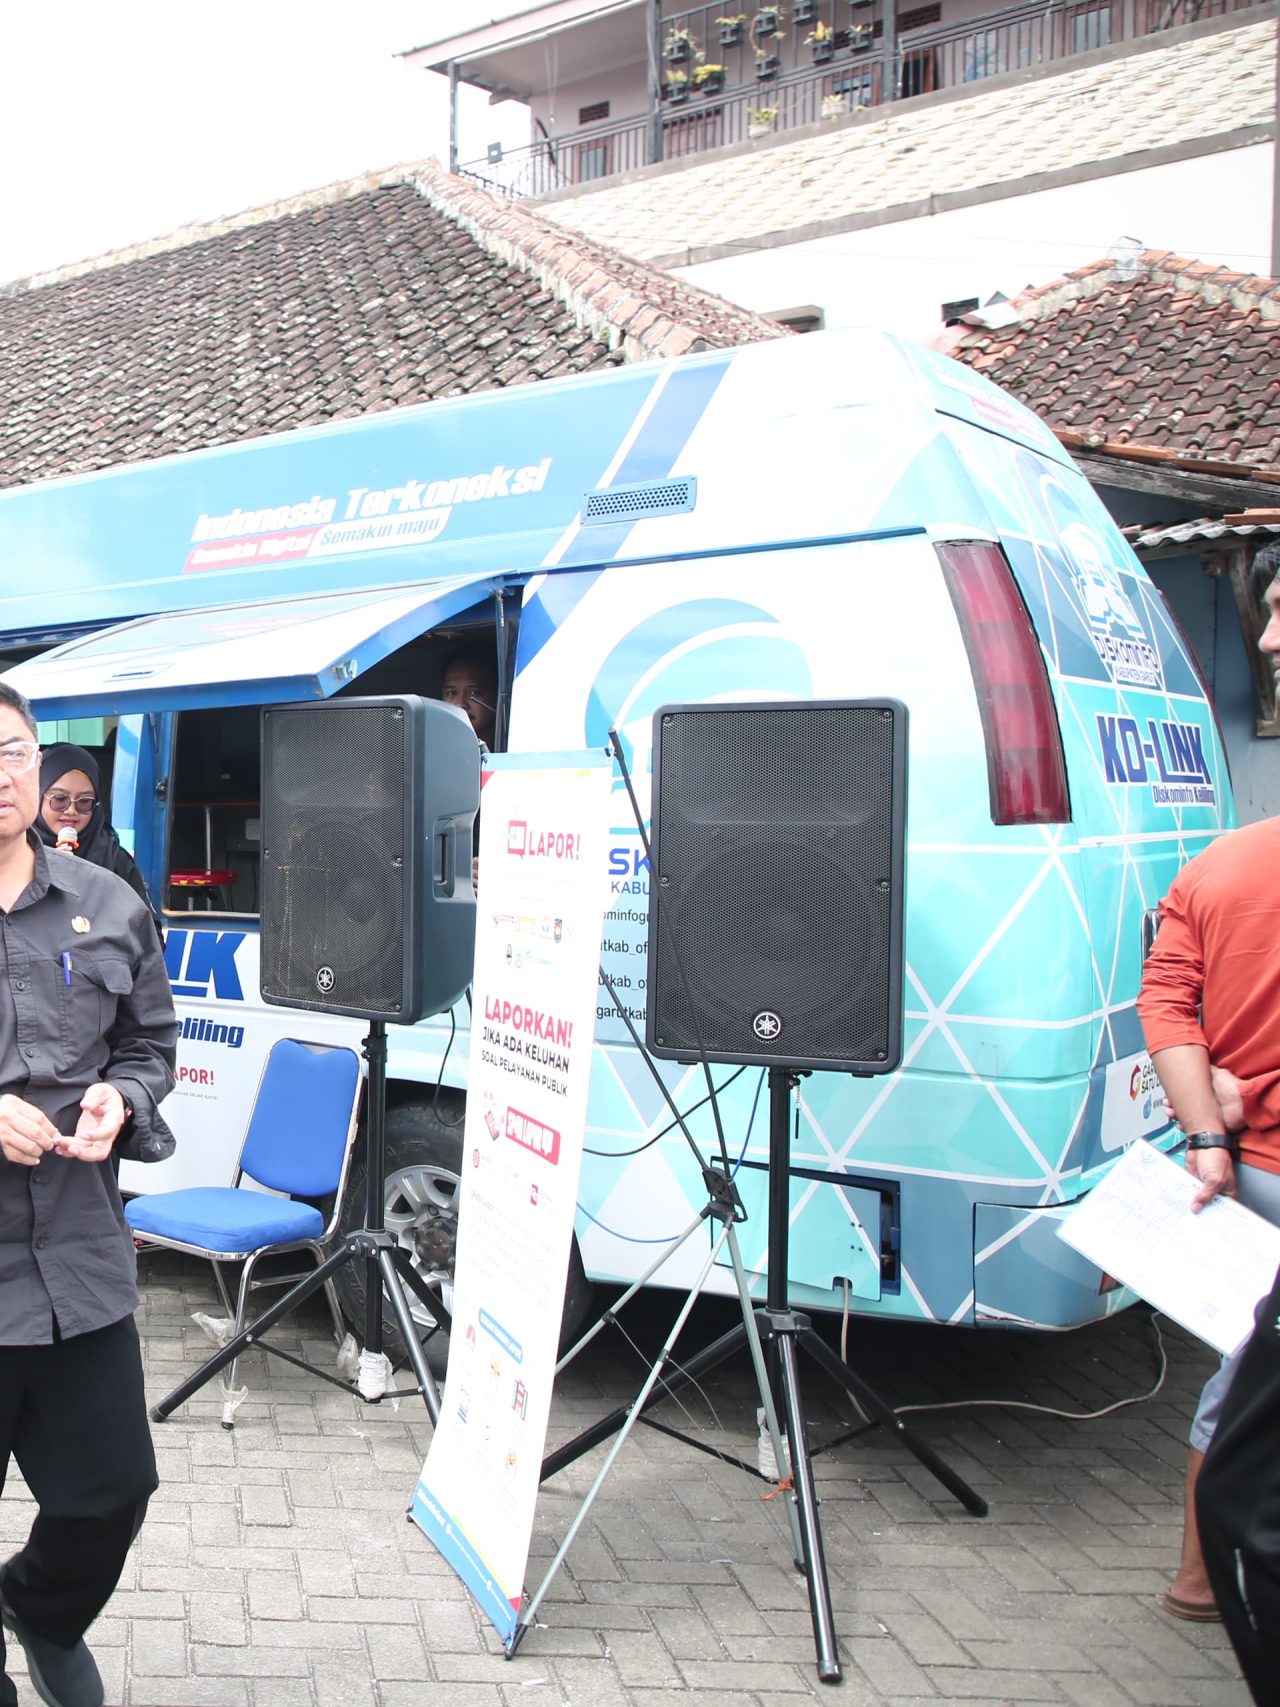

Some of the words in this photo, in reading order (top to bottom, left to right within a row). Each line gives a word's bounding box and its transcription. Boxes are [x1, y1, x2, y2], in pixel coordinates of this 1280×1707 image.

[190, 496, 336, 542] Indonesia
[344, 458, 552, 520] Terkoneksi
[320, 523, 395, 546] Semakin
[396, 515, 441, 538] maju
[1152, 786, 1193, 803] Diskominfo
[528, 831, 581, 861] LAPOR!
[484, 995, 573, 1049] LAPORKAN!
[481, 1049, 498, 1066] SOAL
[499, 1057, 541, 1085] PELAYANAN
[541, 1075, 568, 1097] PUBLIK
[482, 1026, 501, 1046] JIKA
[503, 1034, 523, 1055] ADA
[524, 1041, 570, 1074] KELUHAN
